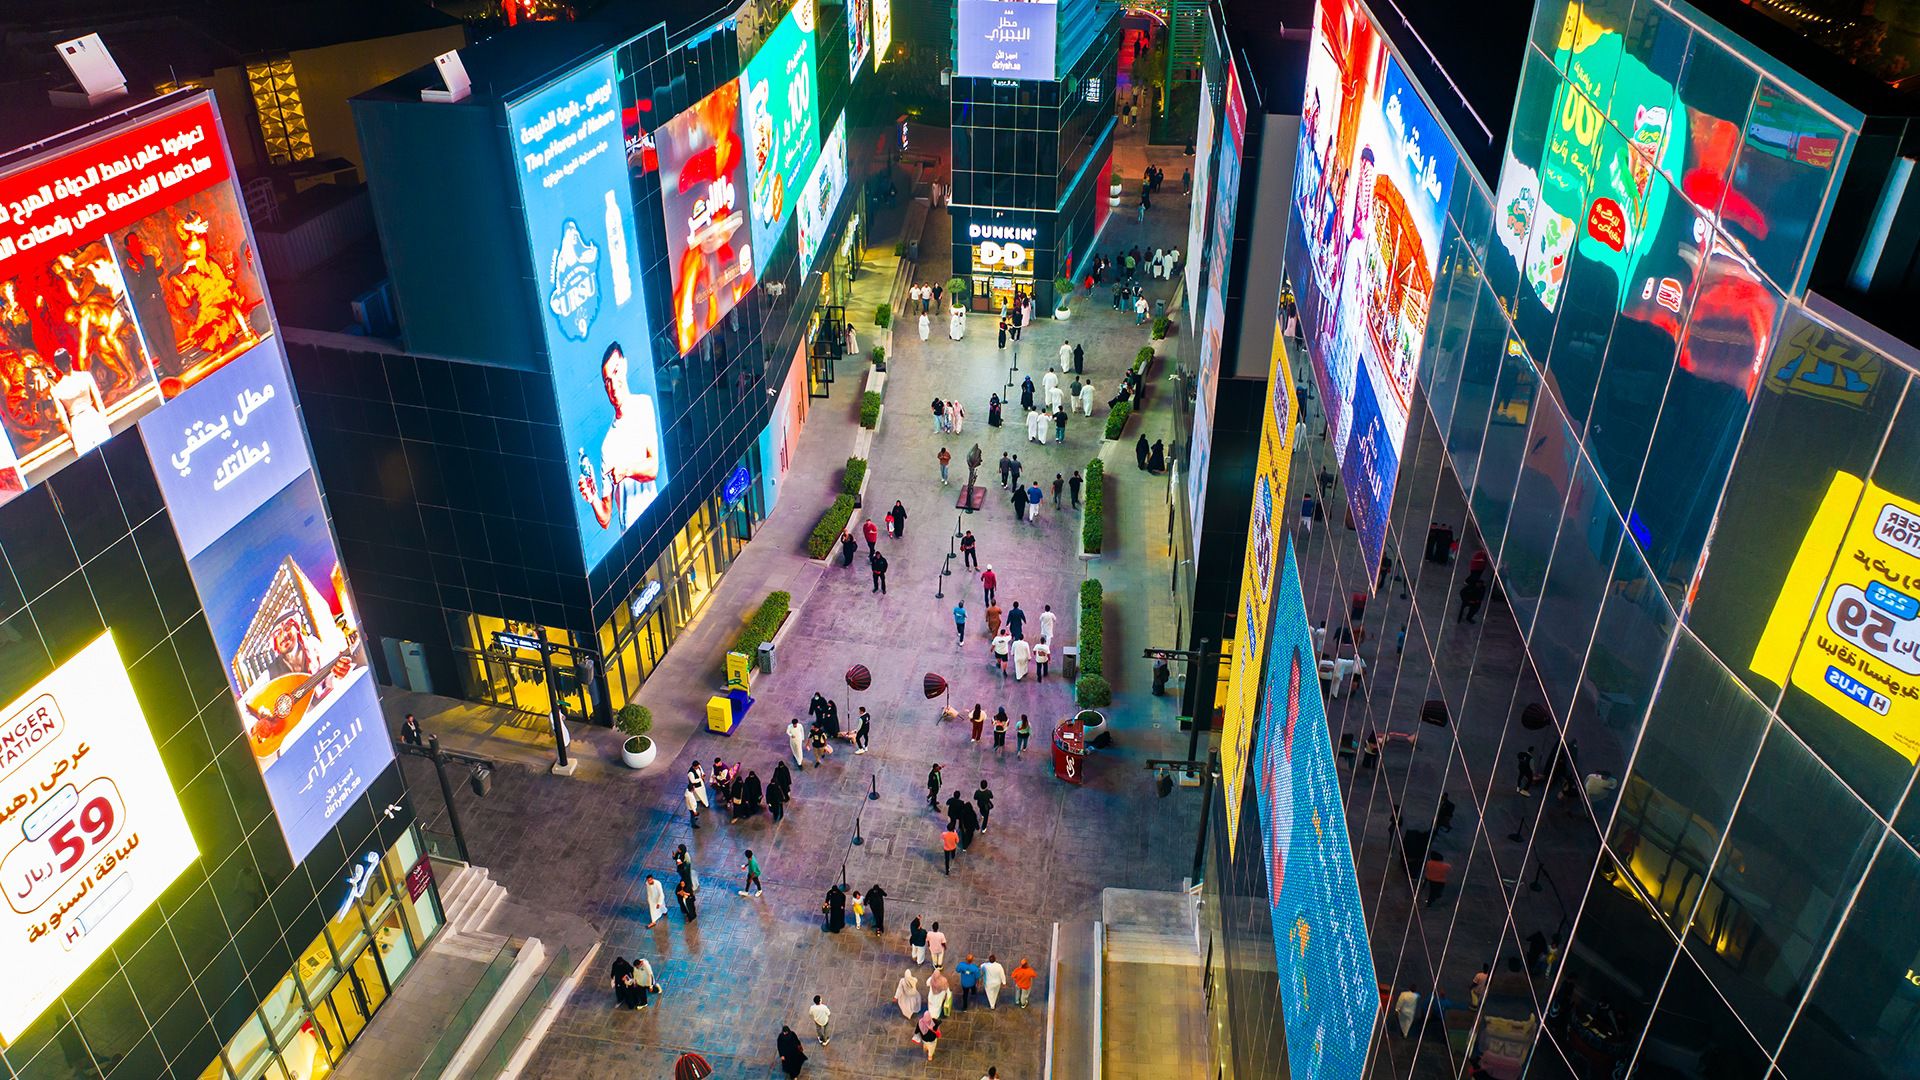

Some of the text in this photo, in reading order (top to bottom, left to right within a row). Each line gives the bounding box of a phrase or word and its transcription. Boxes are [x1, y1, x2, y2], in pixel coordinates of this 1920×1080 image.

[984, 27, 1031, 43] البجيري
[998, 16, 1018, 29] مطل
[788, 61, 810, 126] 100
[132, 144, 161, 171] على
[161, 125, 205, 157] تعرفوا
[524, 149, 546, 173] The
[577, 124, 588, 142] of
[55, 164, 100, 201] الحياة
[98, 155, 132, 181] نمط
[12, 184, 54, 225] المرح
[107, 174, 160, 210] الفخمة
[16, 207, 73, 253] رقصات
[969, 223, 1037, 241] DUNKIN'
[171, 381, 275, 477] مطل يحتفي
[0, 706, 49, 752] NGER
[0, 718, 56, 770] TATION
[312, 725, 342, 763] مطل
[39, 740, 91, 792] عرض
[298, 717, 363, 795] البجيري
[0, 785, 38, 825] رهي
[323, 776, 362, 819] diriyah.sa
[48, 796, 115, 874] 59
[17, 858, 54, 899] ريال
[28, 832, 141, 944] للباقة السنوية
[65, 926, 80, 942] H
